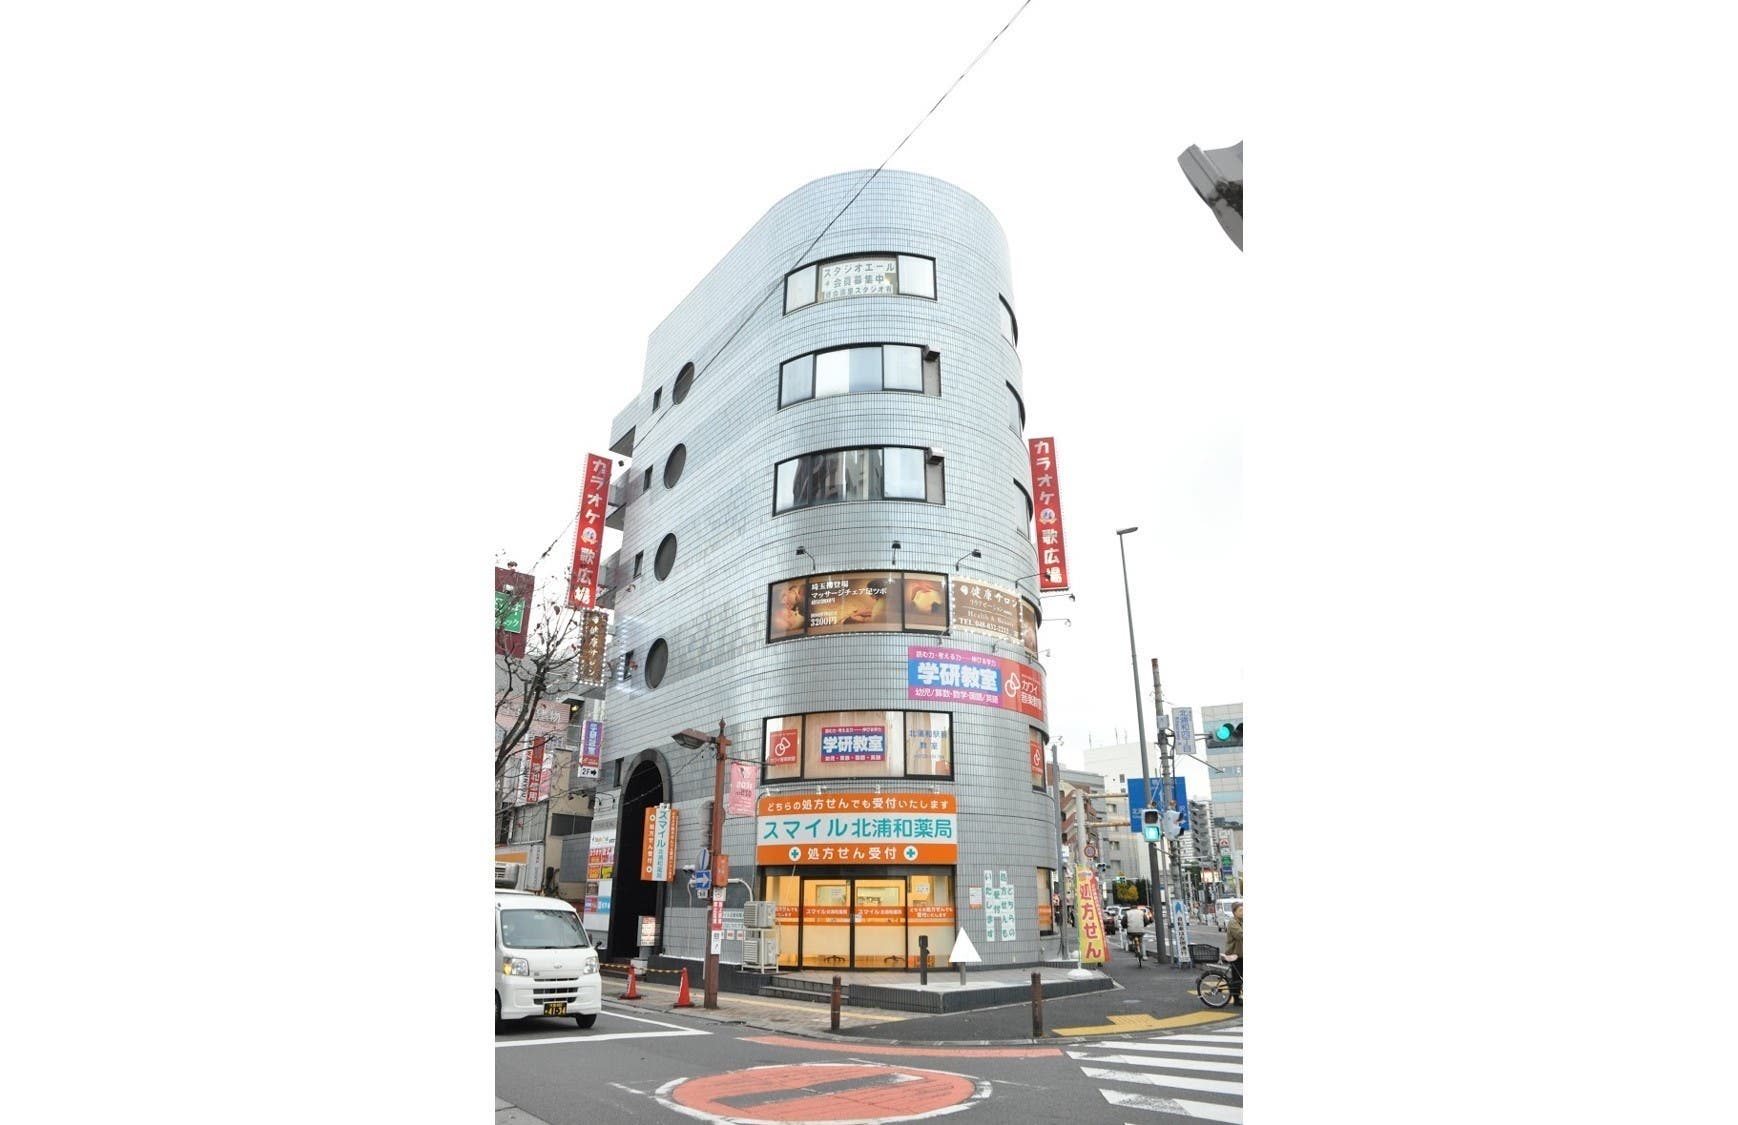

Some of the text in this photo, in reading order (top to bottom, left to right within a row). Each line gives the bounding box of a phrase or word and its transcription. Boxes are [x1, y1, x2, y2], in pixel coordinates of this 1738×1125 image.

[824, 263, 895, 278] スタジオエール
[587, 460, 607, 524] カラオケ
[1034, 440, 1063, 584] カラオケ 歌広場
[917, 661, 998, 692] 学研教室
[1021, 680, 1038, 697] カワイ
[823, 735, 883, 753] 学研教室
[767, 797, 949, 813] どちらの処方せんでも受付いたします
[762, 818, 952, 840] スマイル北浦和薬局
[807, 847, 897, 860] 処方せん受付
[1080, 883, 1101, 959] 処方せん
